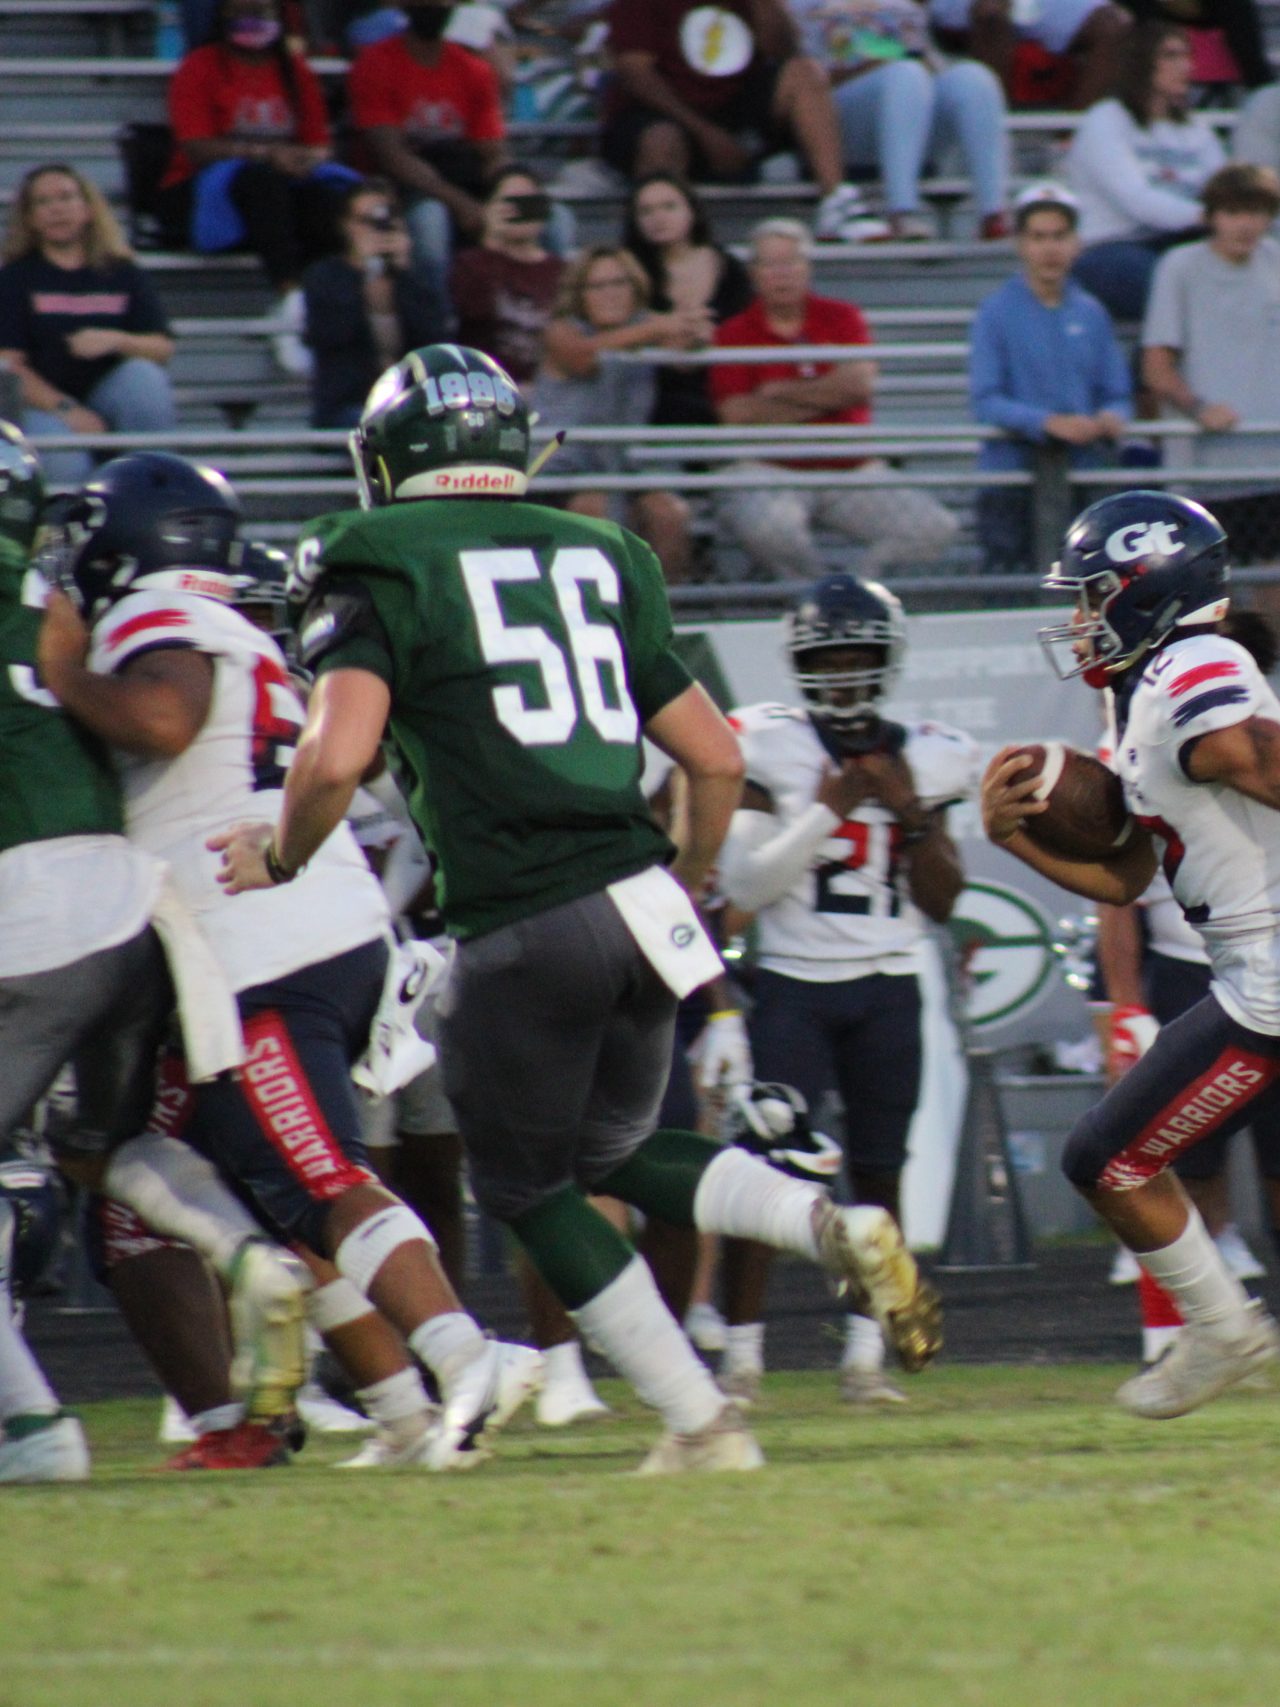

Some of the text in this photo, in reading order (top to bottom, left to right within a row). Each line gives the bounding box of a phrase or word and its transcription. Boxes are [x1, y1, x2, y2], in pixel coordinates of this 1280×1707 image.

[435, 473, 515, 490] Riddell
[1104, 521, 1186, 563] Gt
[459, 548, 639, 747] 56
[246, 1036, 338, 1178] WARRIORS
[1139, 1060, 1264, 1157] WARRIORS
